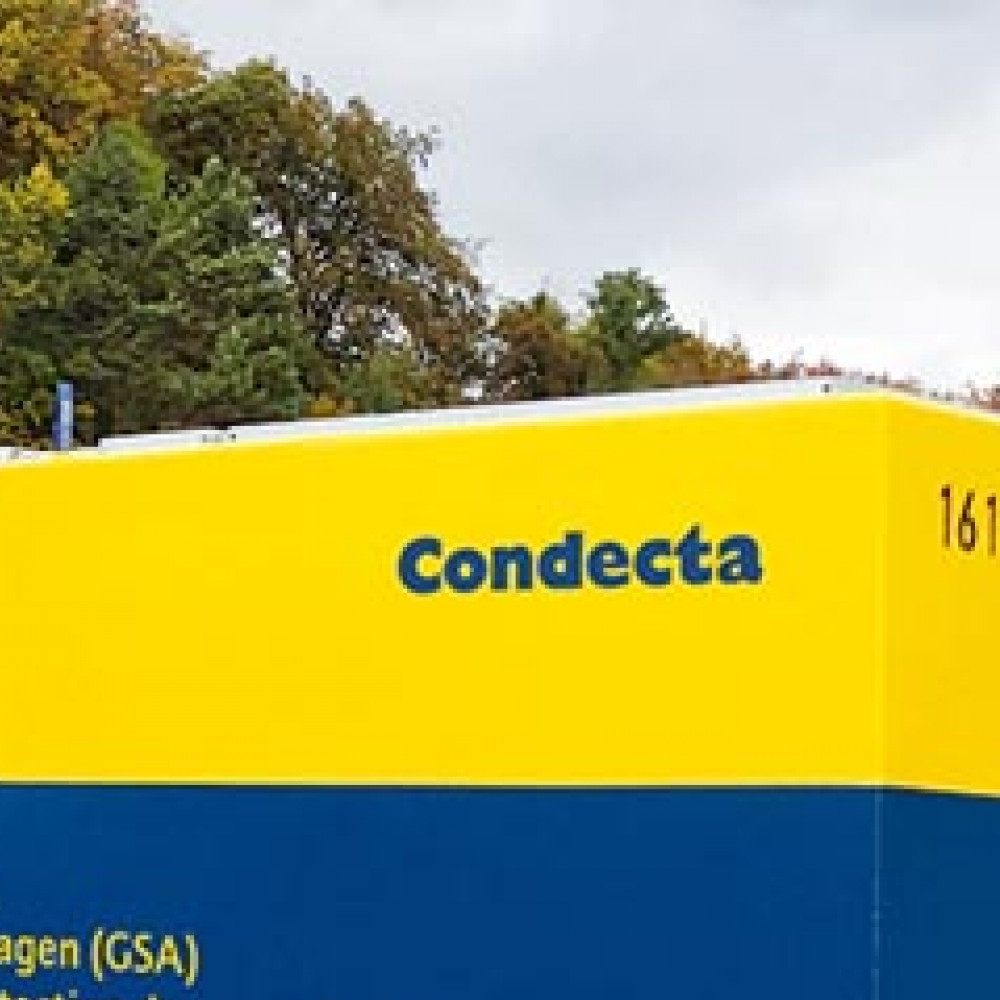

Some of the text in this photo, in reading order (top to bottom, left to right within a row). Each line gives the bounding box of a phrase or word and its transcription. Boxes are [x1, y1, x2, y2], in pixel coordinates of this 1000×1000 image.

[940, 484, 998, 556] 161
[399, 524, 762, 592] Condecta
[91, 927, 199, 987] (GSA)
